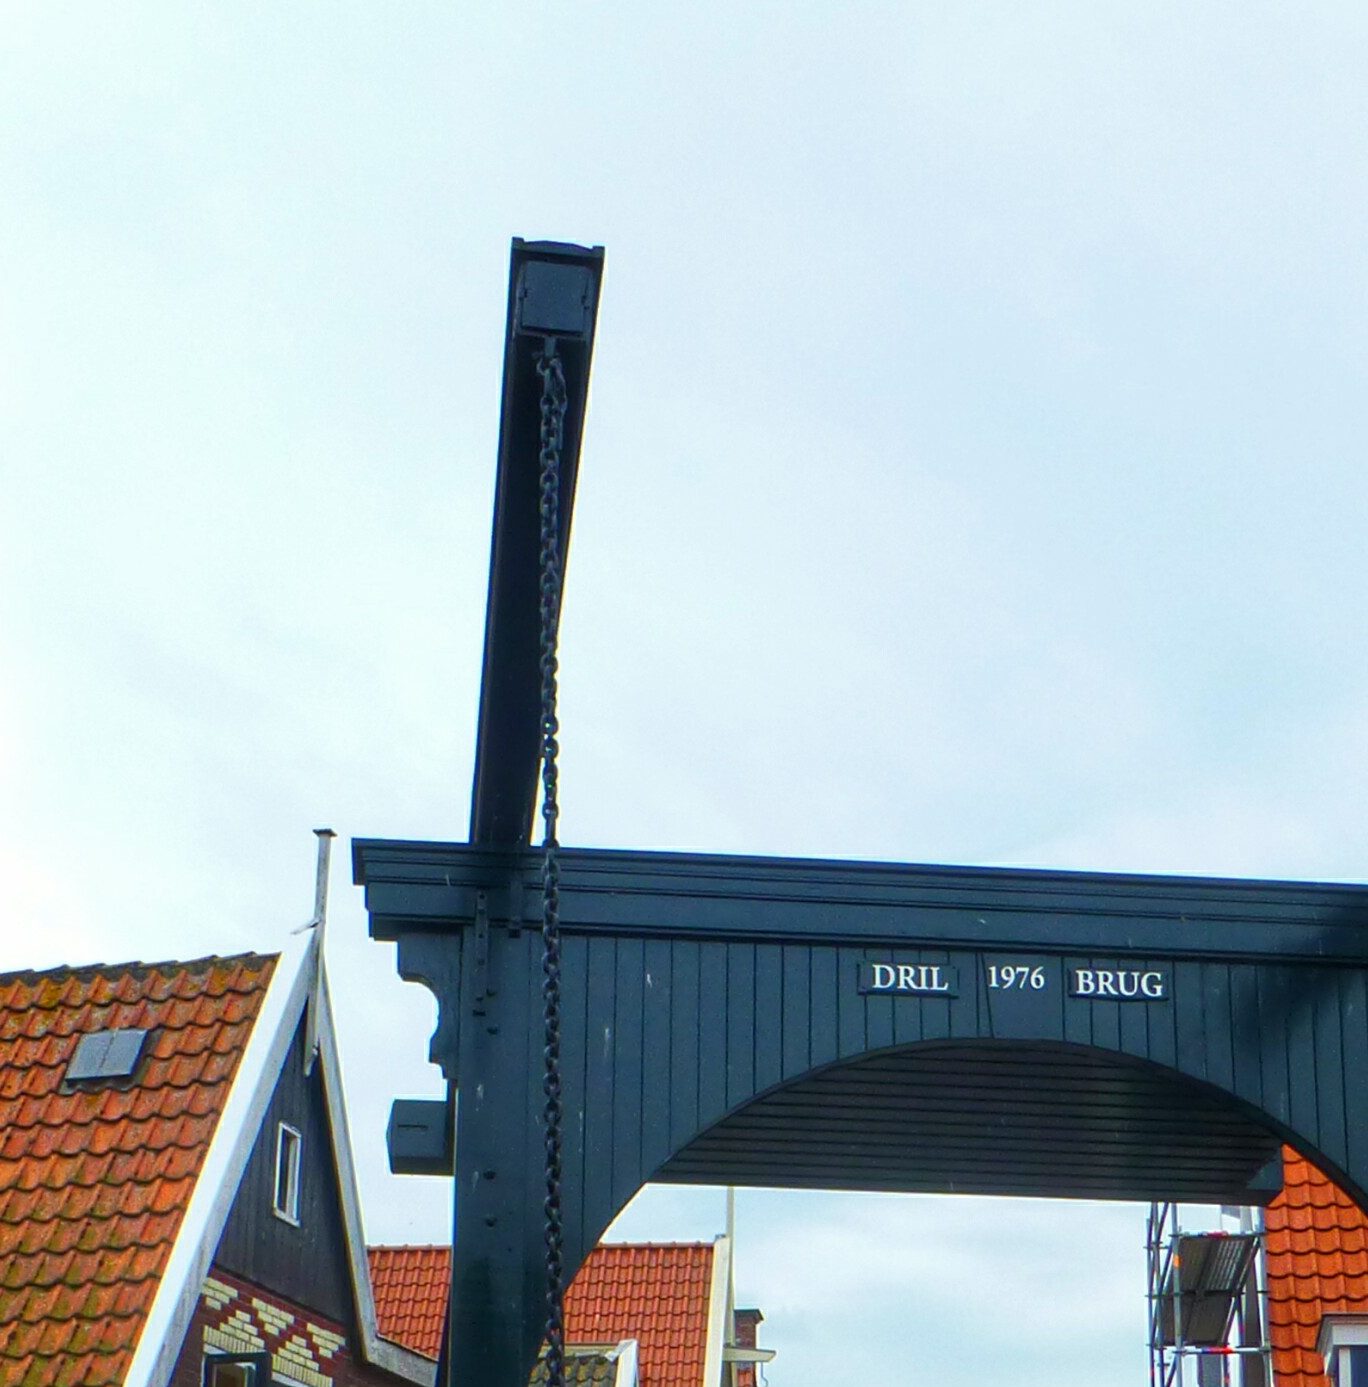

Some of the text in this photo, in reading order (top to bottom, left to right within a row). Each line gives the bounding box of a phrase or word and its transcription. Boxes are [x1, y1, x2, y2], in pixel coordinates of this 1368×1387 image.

[871, 963, 950, 991] DRIL
[988, 965, 1046, 990] 1976
[1075, 970, 1164, 997] BRUG
